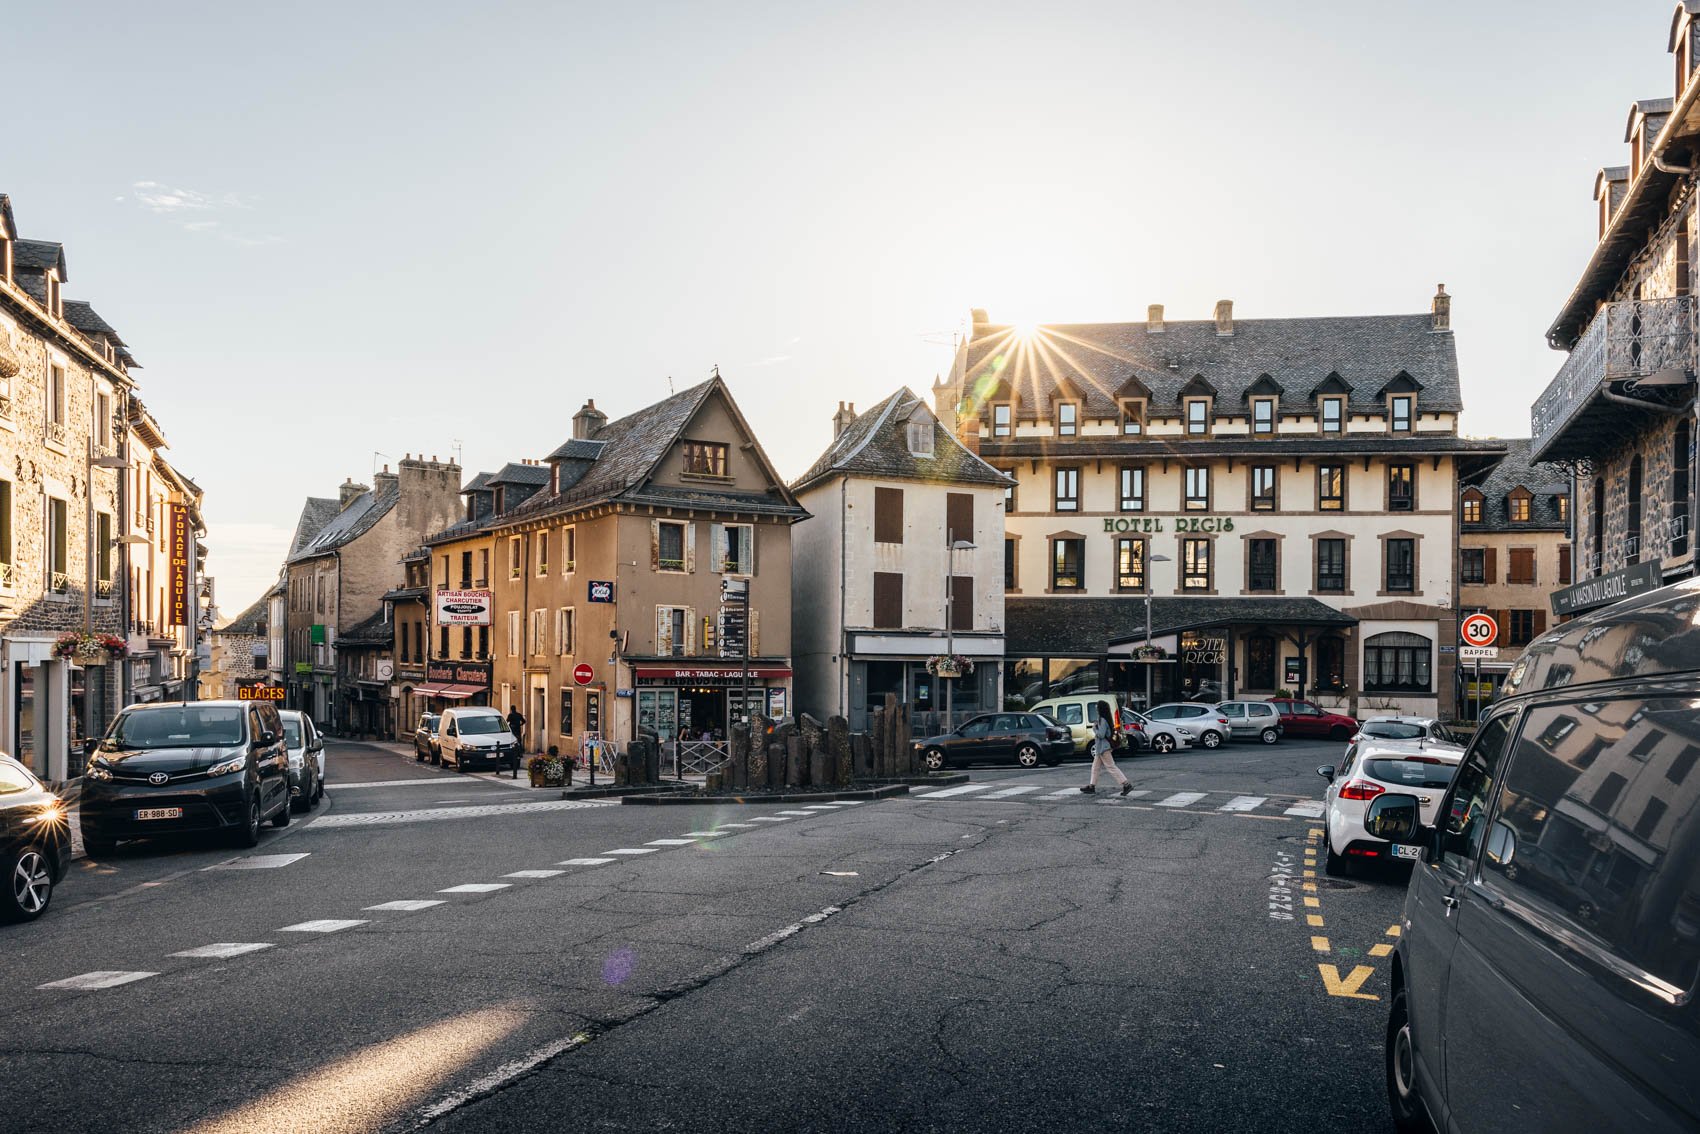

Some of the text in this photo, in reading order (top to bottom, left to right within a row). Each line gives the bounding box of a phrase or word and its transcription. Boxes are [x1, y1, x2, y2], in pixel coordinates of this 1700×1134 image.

[173, 506, 187, 514] LA
[1103, 517, 1234, 533] HOTEL REGIS
[176, 514, 184, 557] FOUACE
[172, 558, 187, 566] DE
[175, 566, 184, 624] LAGUIOLE
[1469, 623, 1491, 638] 30
[1185, 651, 1226, 665] REGIS
[239, 687, 285, 700] GLACES
[139, 809, 178, 819] ER-988-SD
